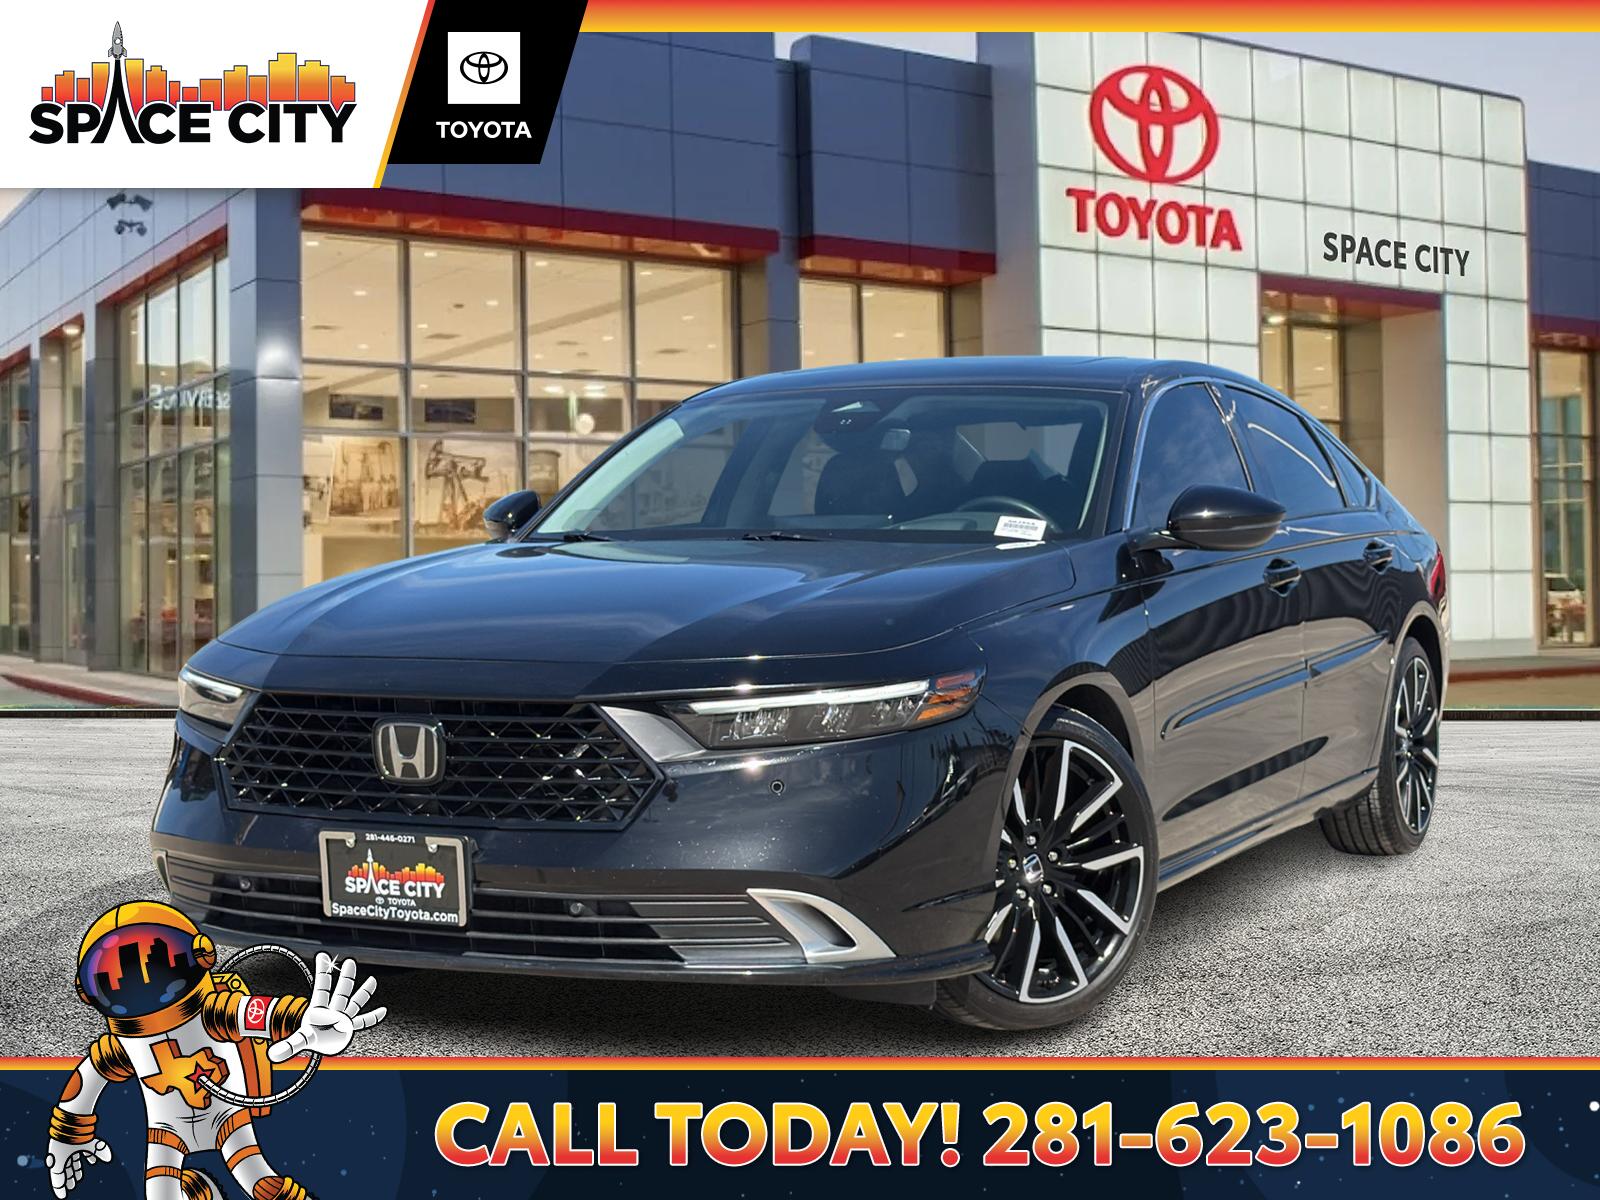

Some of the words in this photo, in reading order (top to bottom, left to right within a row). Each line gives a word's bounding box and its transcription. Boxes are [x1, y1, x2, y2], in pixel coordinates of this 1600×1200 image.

[1066, 187, 1242, 251] TOYOTA
[1323, 231, 1407, 269] SPACE
[1414, 243, 1470, 277] CITY
[345, 876, 400, 895] SPACE
[404, 881, 445, 898] CITY
[331, 902, 459, 923] SpaceCityToyota.com
[387, 897, 416, 907] TOYOTA
